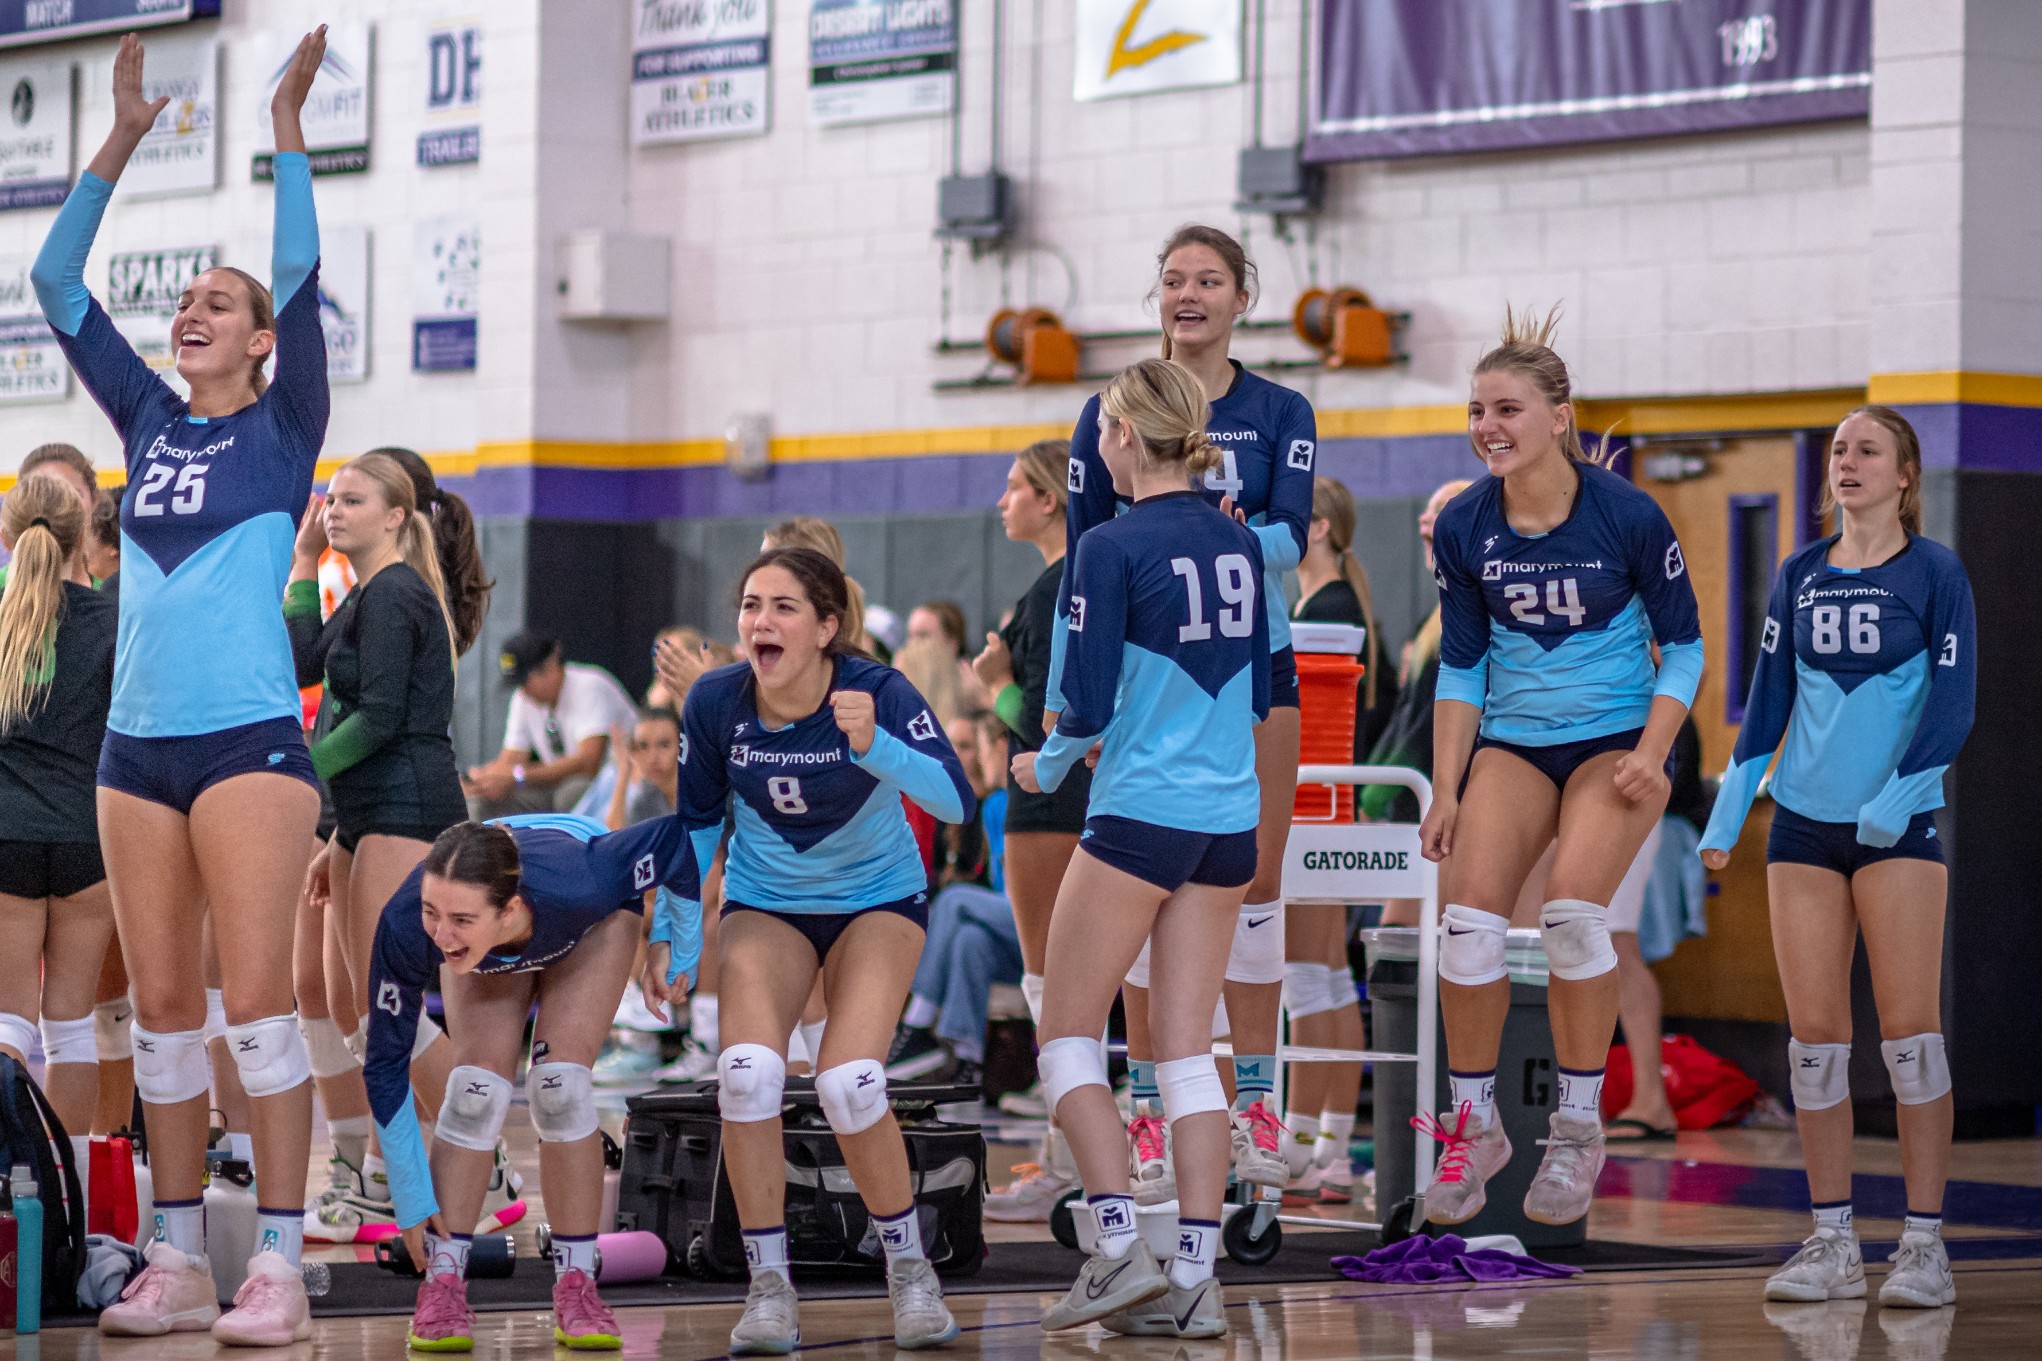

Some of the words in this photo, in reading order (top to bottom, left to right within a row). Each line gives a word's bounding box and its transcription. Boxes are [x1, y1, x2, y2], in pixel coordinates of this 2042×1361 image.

[1717, 14, 1777, 66] 1993
[134, 462, 210, 518] 25
[1170, 553, 1256, 643] 19
[1503, 577, 1587, 626] 24
[1811, 603, 1881, 654] 86
[749, 747, 842, 767] marymount
[767, 776, 808, 815] 8
[1303, 851, 1408, 871] GATORADE
